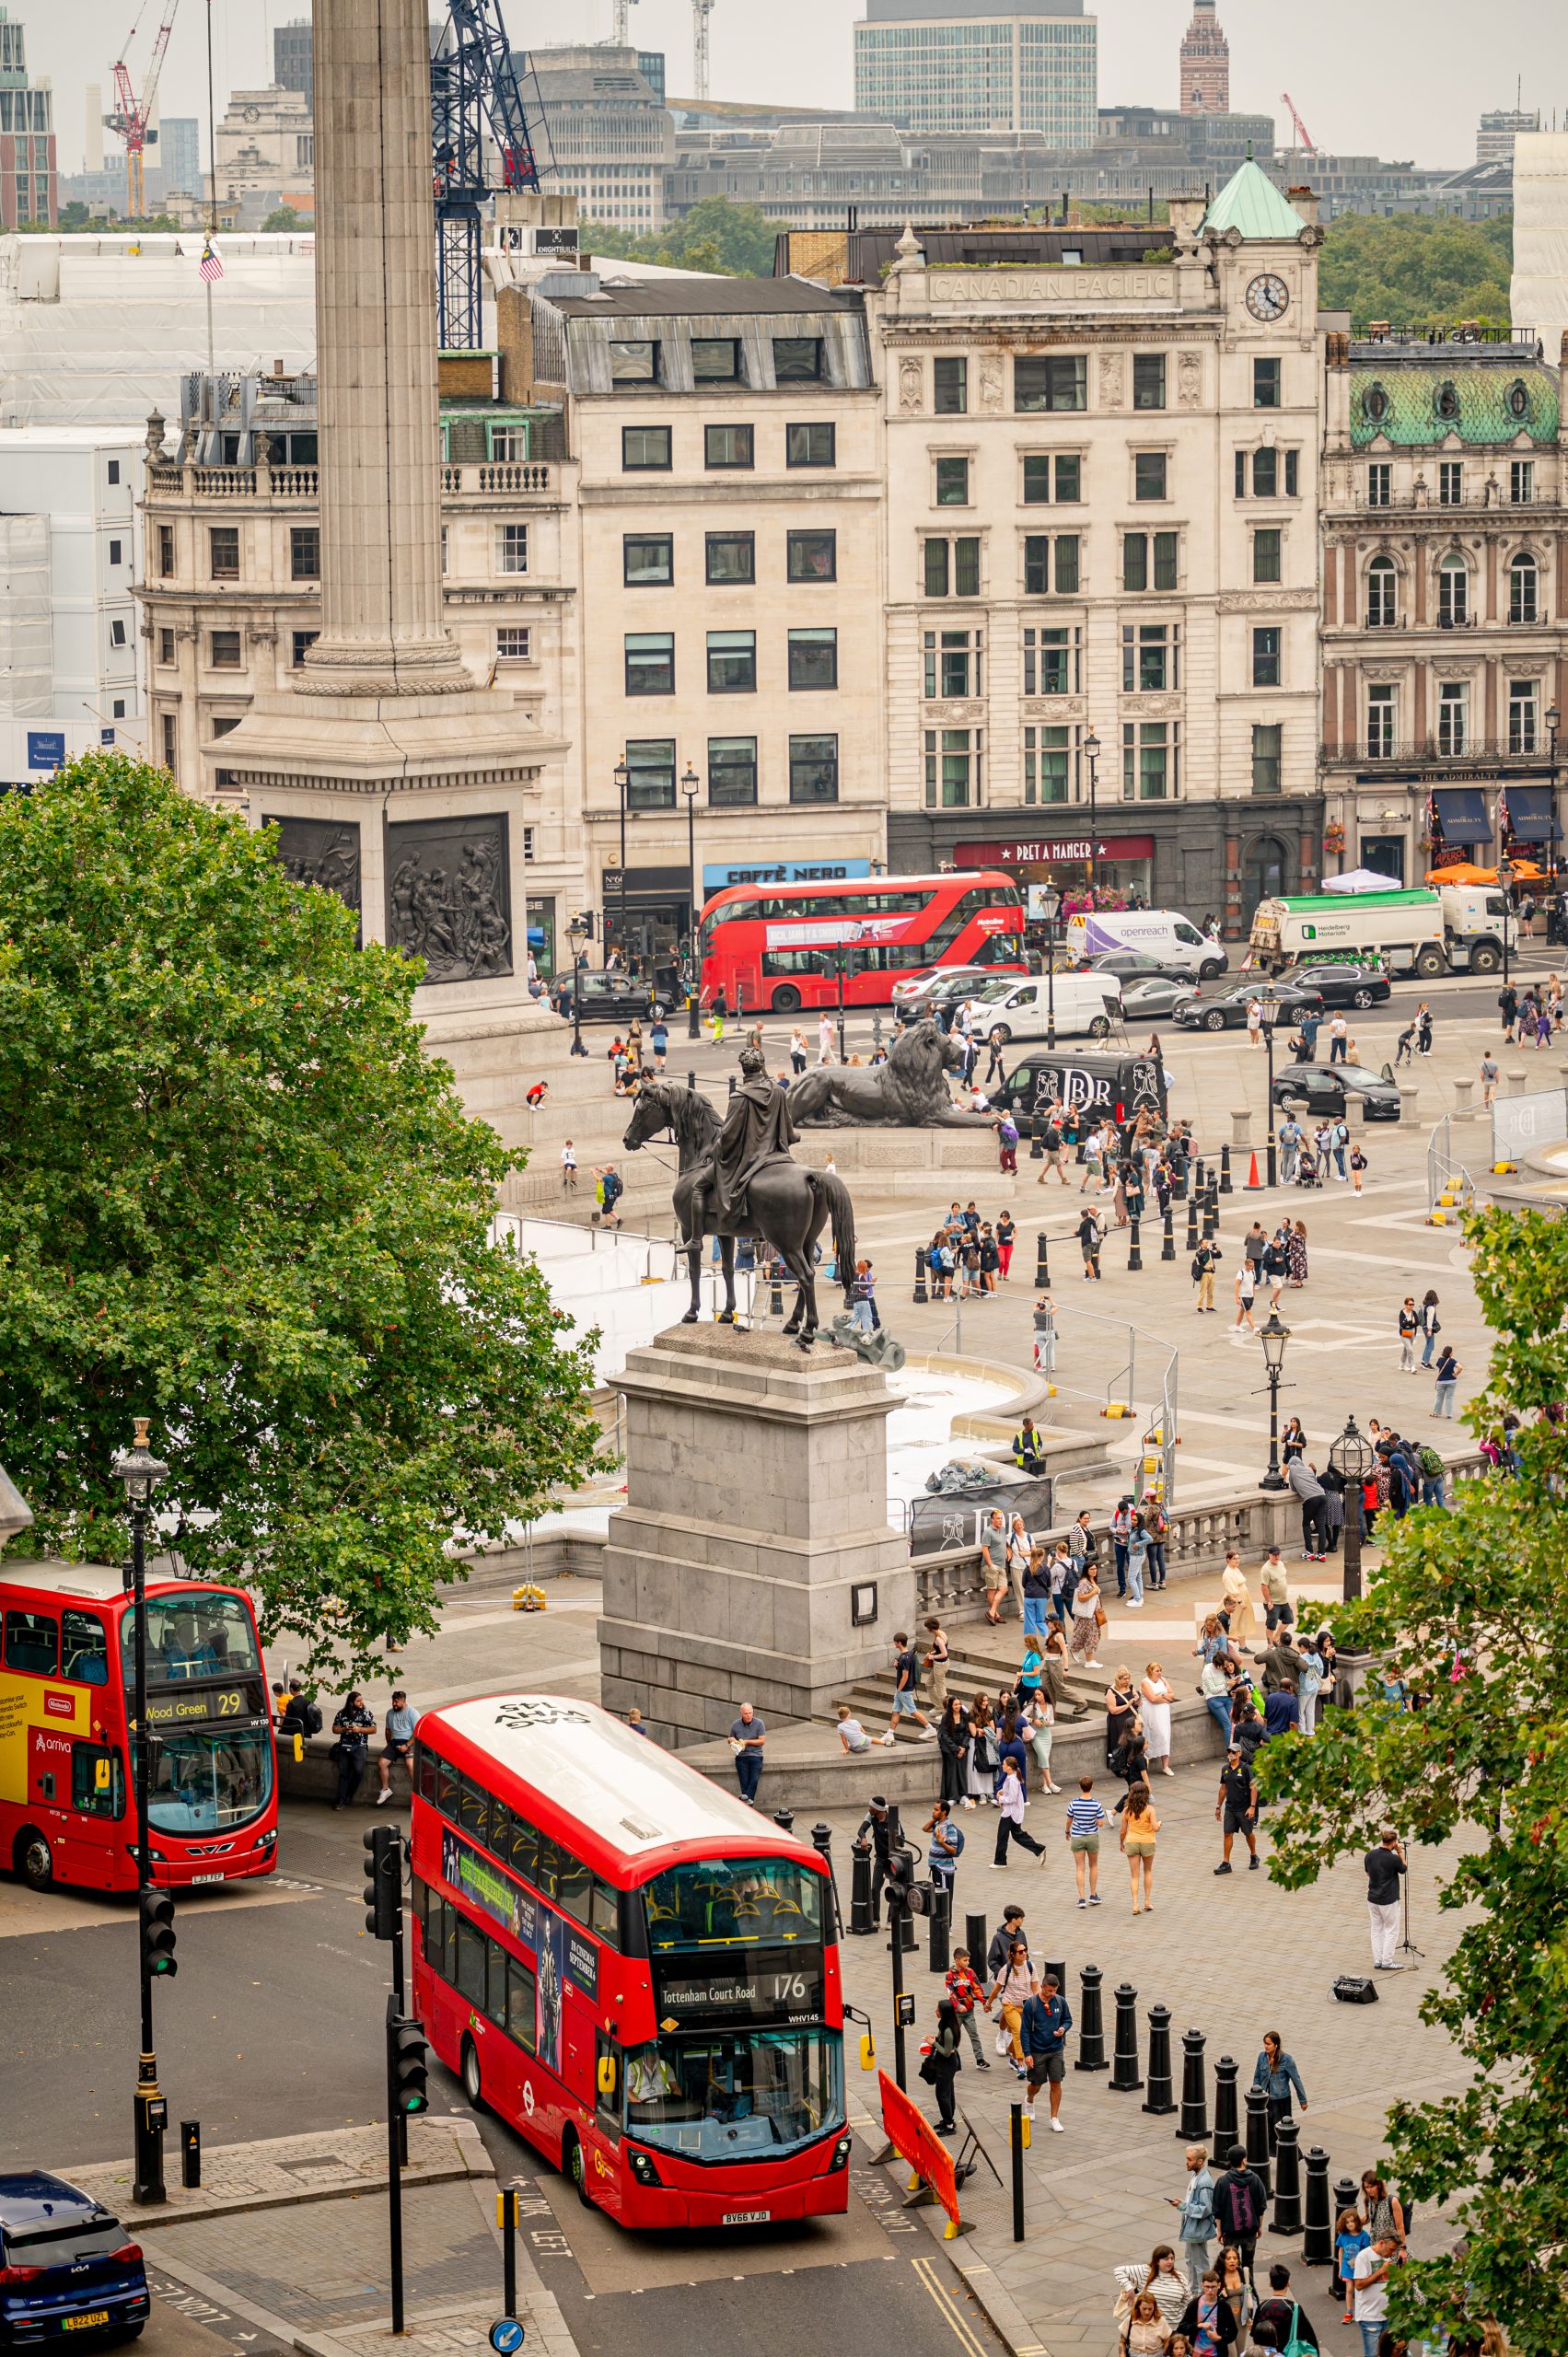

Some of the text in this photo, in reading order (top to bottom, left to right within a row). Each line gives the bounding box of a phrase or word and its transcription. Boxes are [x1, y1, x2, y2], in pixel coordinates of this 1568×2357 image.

[935, 274, 1169, 299] CANADIAN PACIFIC
[1418, 772, 1499, 782] THE ADMIRALTY
[1016, 842, 1092, 861] PRET A MANGER
[1435, 849, 1467, 864] APEROL
[795, 866, 846, 880] NERO
[977, 917, 1005, 925] Metroline
[1121, 925, 1168, 937] openreach
[50, 1700, 70, 1711] Nintendo
[176, 1702, 207, 1716] Green
[218, 1692, 240, 1715] 29
[46, 1738, 71, 1753] arriva
[193, 1873, 222, 1884] LJ13 FEP
[264, 1877, 323, 1892] LOOK
[571, 1939, 595, 1968] IN CINEMAS
[569, 1951, 593, 1979] SEPTEMBER
[662, 1973, 806, 2004] Tottenham Court Road 176
[788, 2014, 819, 2024] WHV145
[518, 2193, 553, 2217] LOOK
[726, 2212, 767, 2223] BV66 VJD
[530, 2230, 574, 2258] LEFT
[166, 2296, 231, 2324] LOOK
[66, 2312, 108, 2328] LB22 UZL
